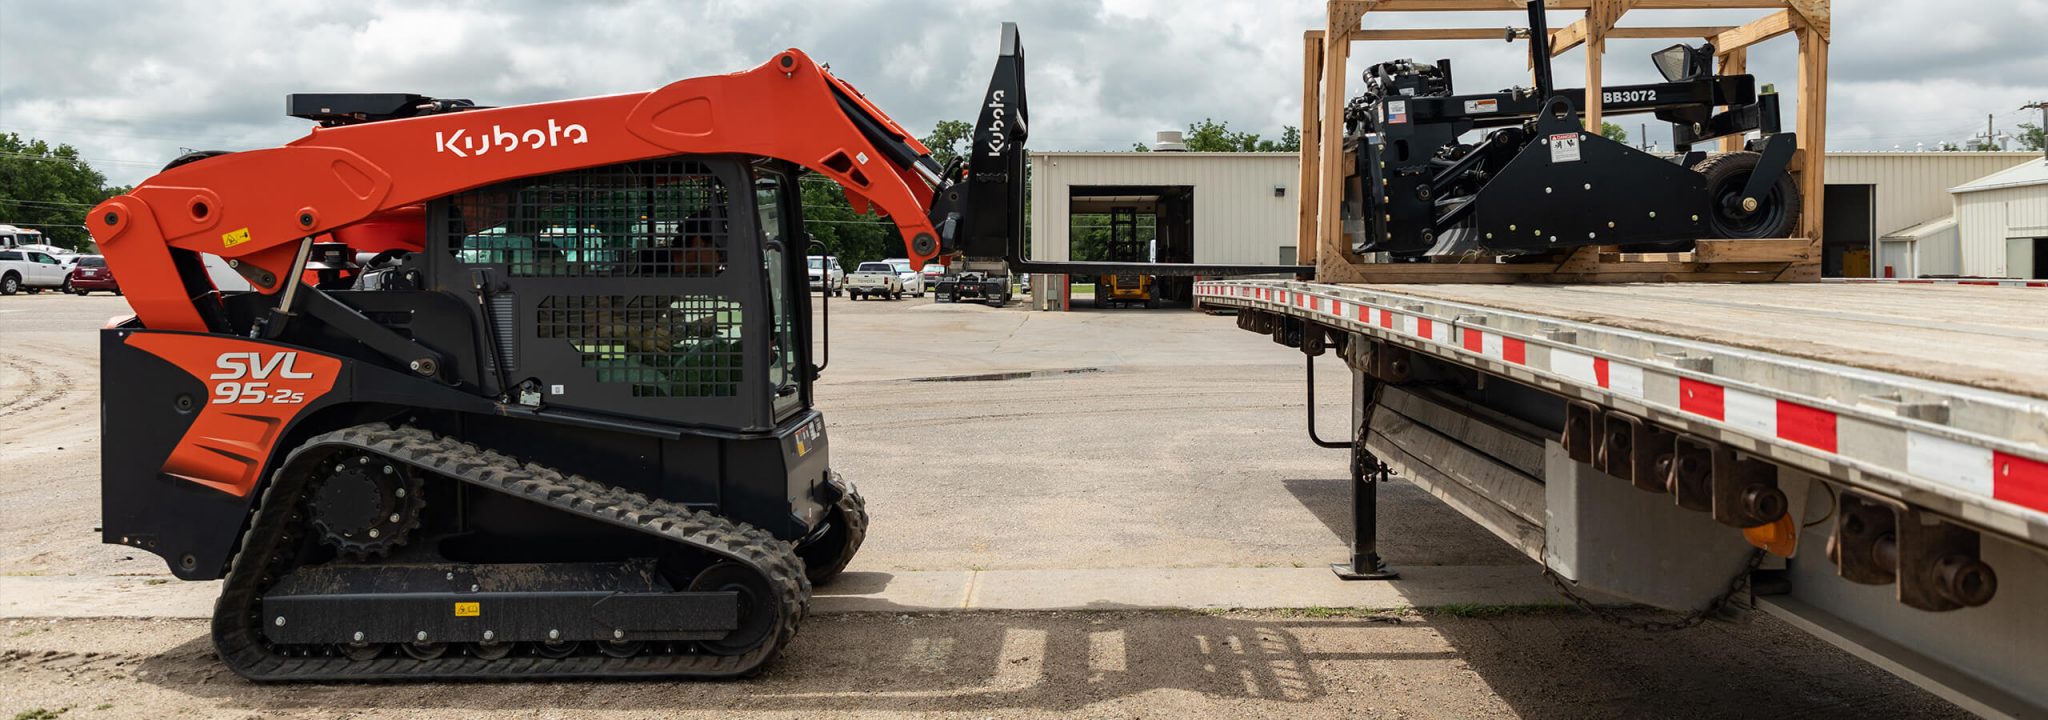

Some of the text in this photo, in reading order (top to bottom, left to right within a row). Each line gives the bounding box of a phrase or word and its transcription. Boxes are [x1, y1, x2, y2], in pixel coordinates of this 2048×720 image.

[1603, 90, 1657, 104] BB3072
[435, 118, 588, 157] Kubota
[988, 90, 1005, 156] Kubota
[210, 352, 314, 380] SVL
